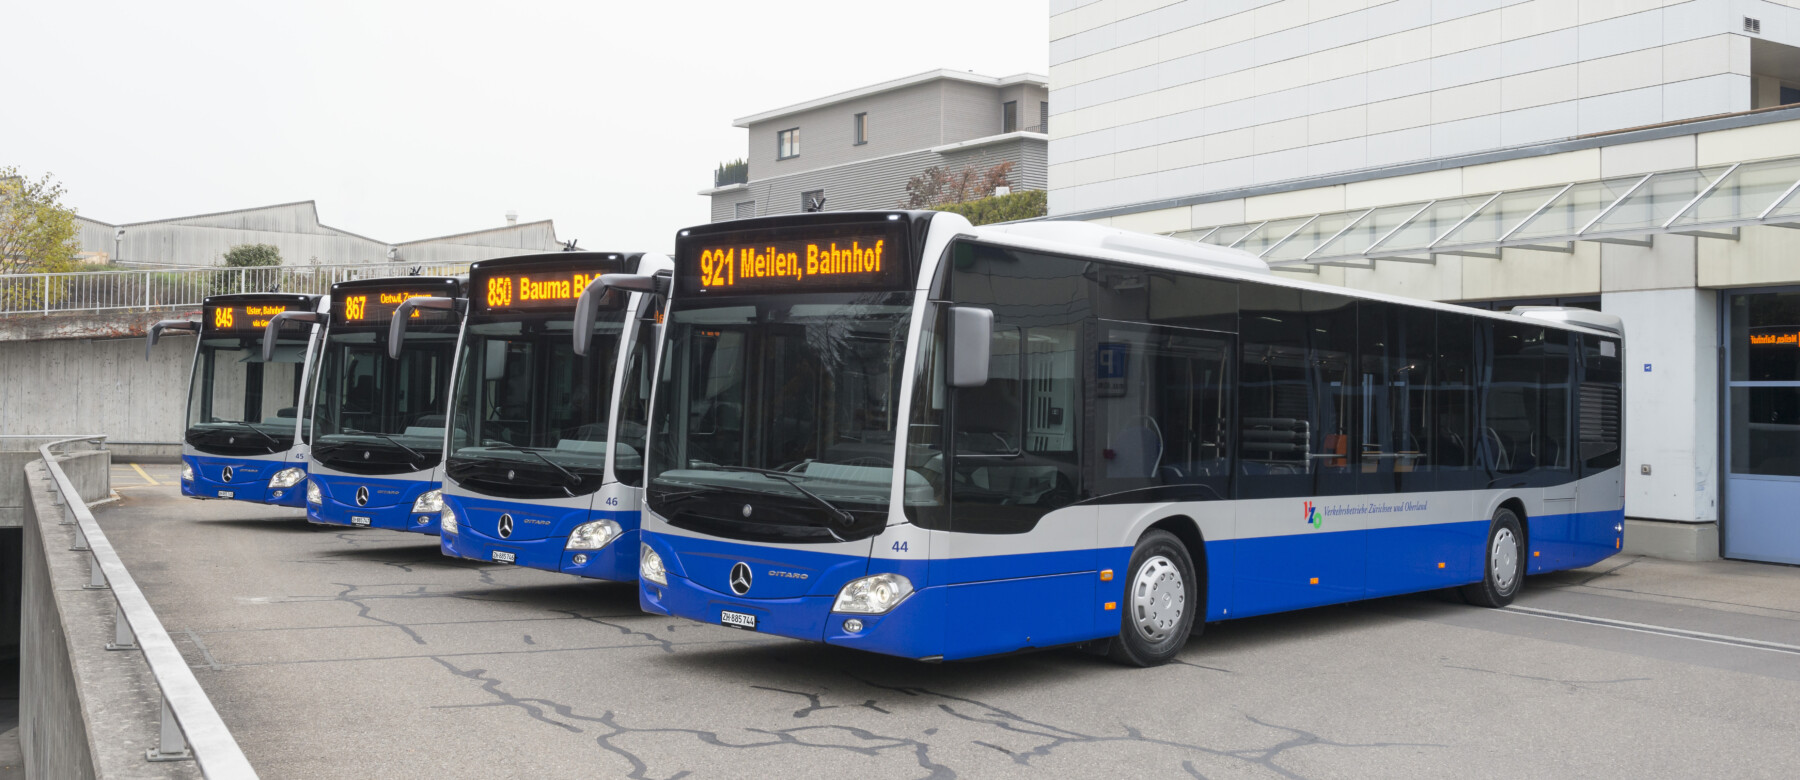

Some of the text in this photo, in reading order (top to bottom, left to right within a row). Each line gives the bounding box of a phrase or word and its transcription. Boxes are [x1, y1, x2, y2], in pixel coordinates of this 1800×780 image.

[701, 240, 883, 286] 921 Meilen, Bahnhof
[487, 273, 601, 306] 850 Bauma Bh
[215, 307, 233, 327] 845
[346, 296, 366, 320] 867
[606, 497, 618, 506] 46
[891, 541, 908, 552] 44
[768, 570, 809, 580] CITARO
